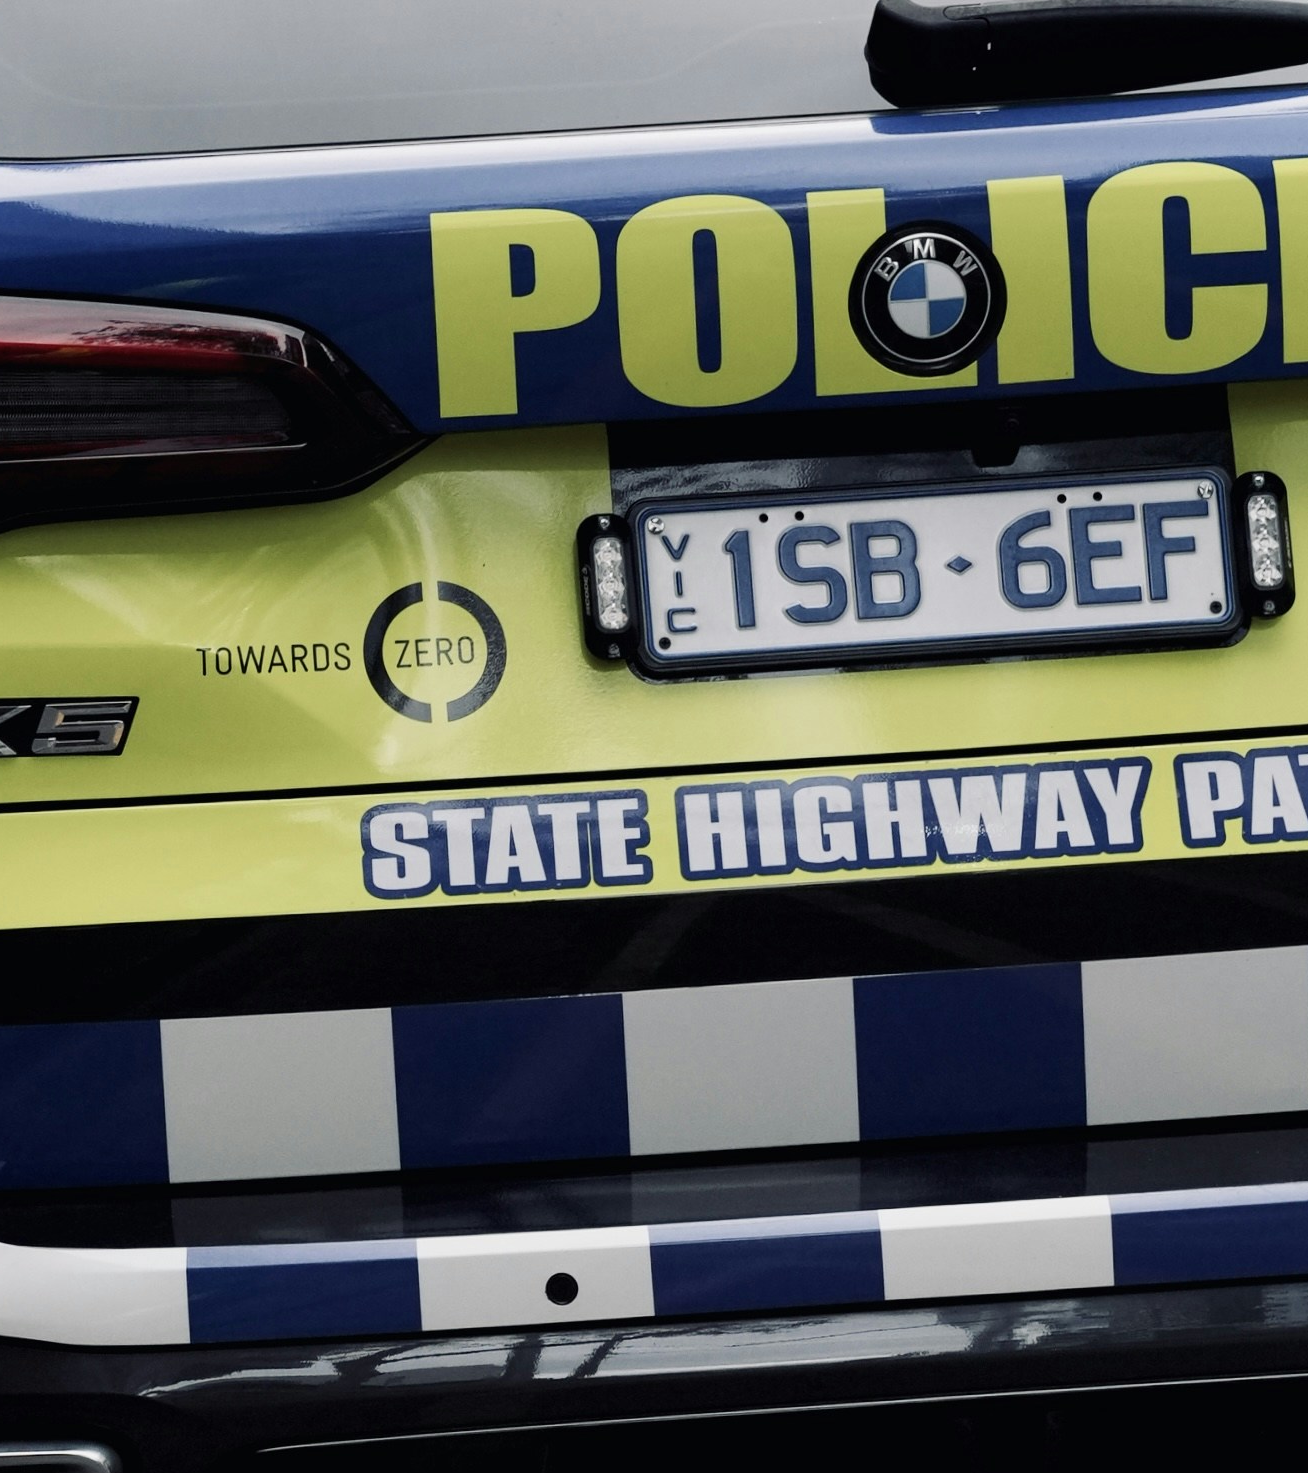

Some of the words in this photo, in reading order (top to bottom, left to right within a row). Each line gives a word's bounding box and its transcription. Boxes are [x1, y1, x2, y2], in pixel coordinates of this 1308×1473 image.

[874, 237, 978, 282] BMW
[661, 534, 698, 633] VIC
[722, 519, 921, 631] 1SB
[995, 500, 1210, 610] 6EF
[195, 642, 352, 677] TOWARDS
[394, 635, 476, 669] ZERO
[369, 797, 645, 891] STATE
[684, 765, 1143, 873] HIGHWAY
